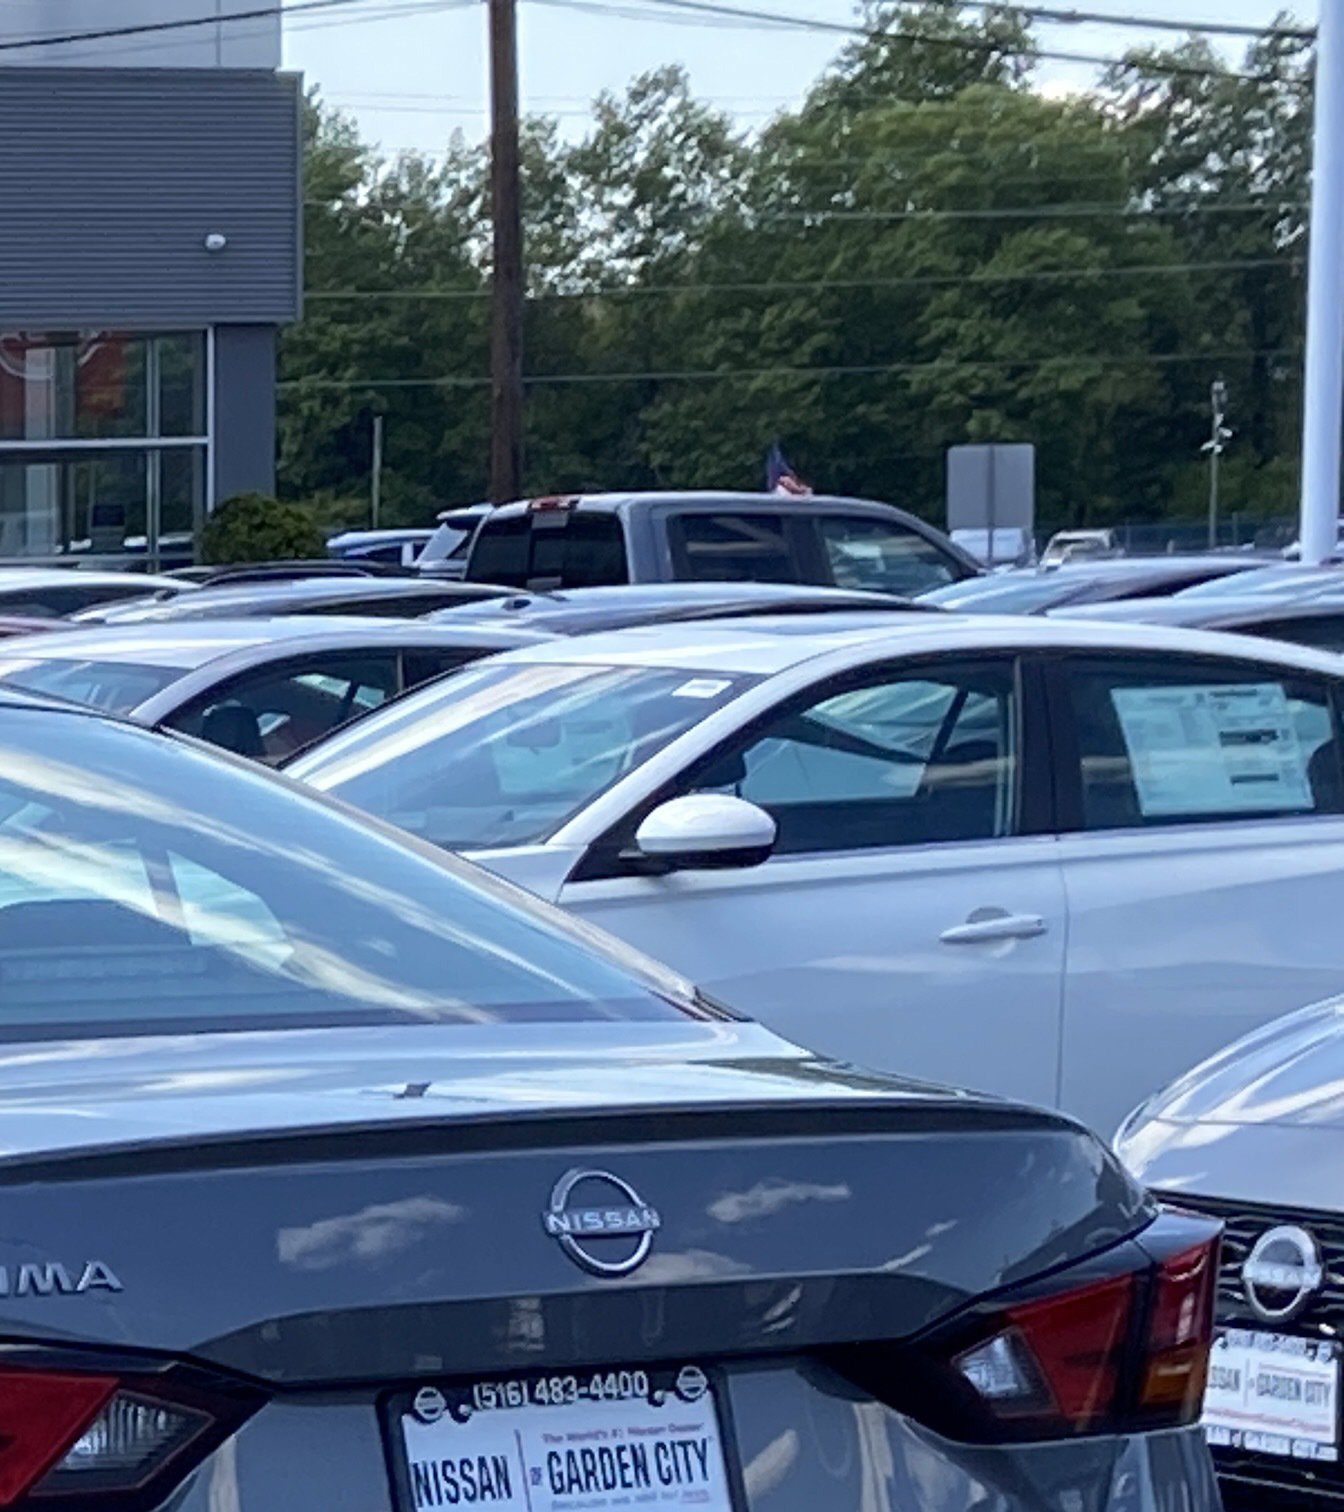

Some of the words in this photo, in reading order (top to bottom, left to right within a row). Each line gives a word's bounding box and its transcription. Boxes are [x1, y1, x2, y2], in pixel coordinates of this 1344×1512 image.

[546, 1208, 660, 1234] NISSAN
[472, 1380, 529, 1411] (516)
[534, 1370, 649, 1406] 483-4400
[411, 1455, 513, 1508] NISSAN
[547, 1443, 651, 1495] GARDEN
[654, 1438, 709, 1485] CITY
